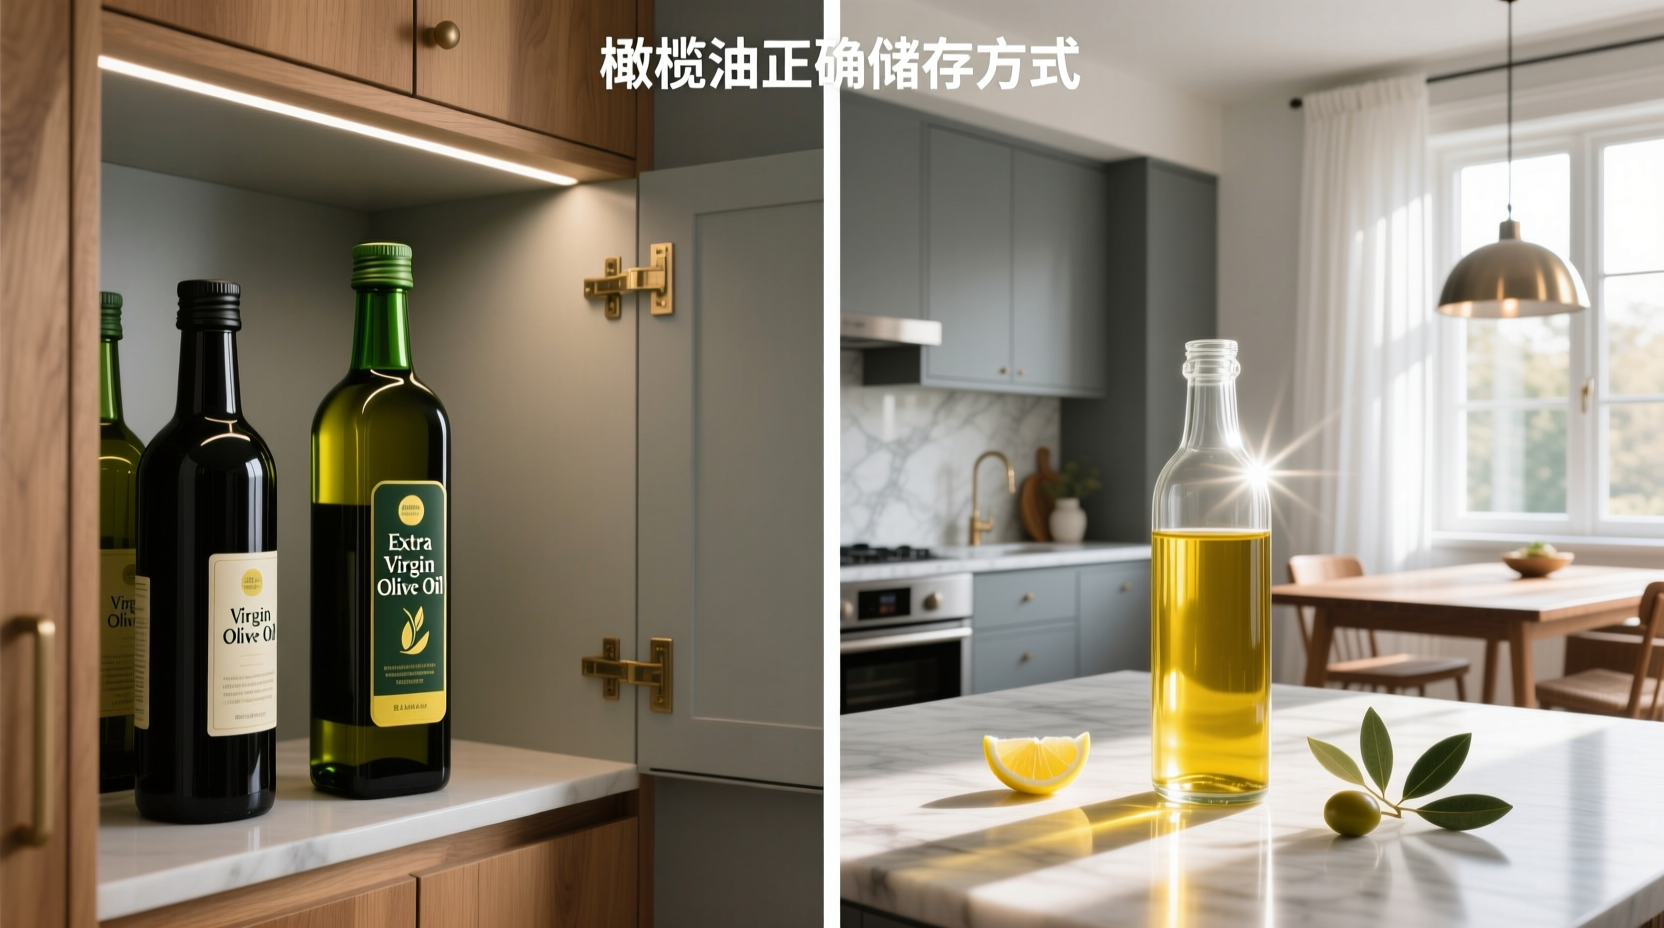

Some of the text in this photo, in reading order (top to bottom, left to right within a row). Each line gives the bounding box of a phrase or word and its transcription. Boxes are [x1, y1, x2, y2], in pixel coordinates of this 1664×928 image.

[388, 533, 433, 551] Extra
[383, 555, 435, 578] Virgin
[377, 576, 444, 596] Olive Oil
[230, 607, 271, 627] Virgin
[223, 627, 260, 645] Olive
